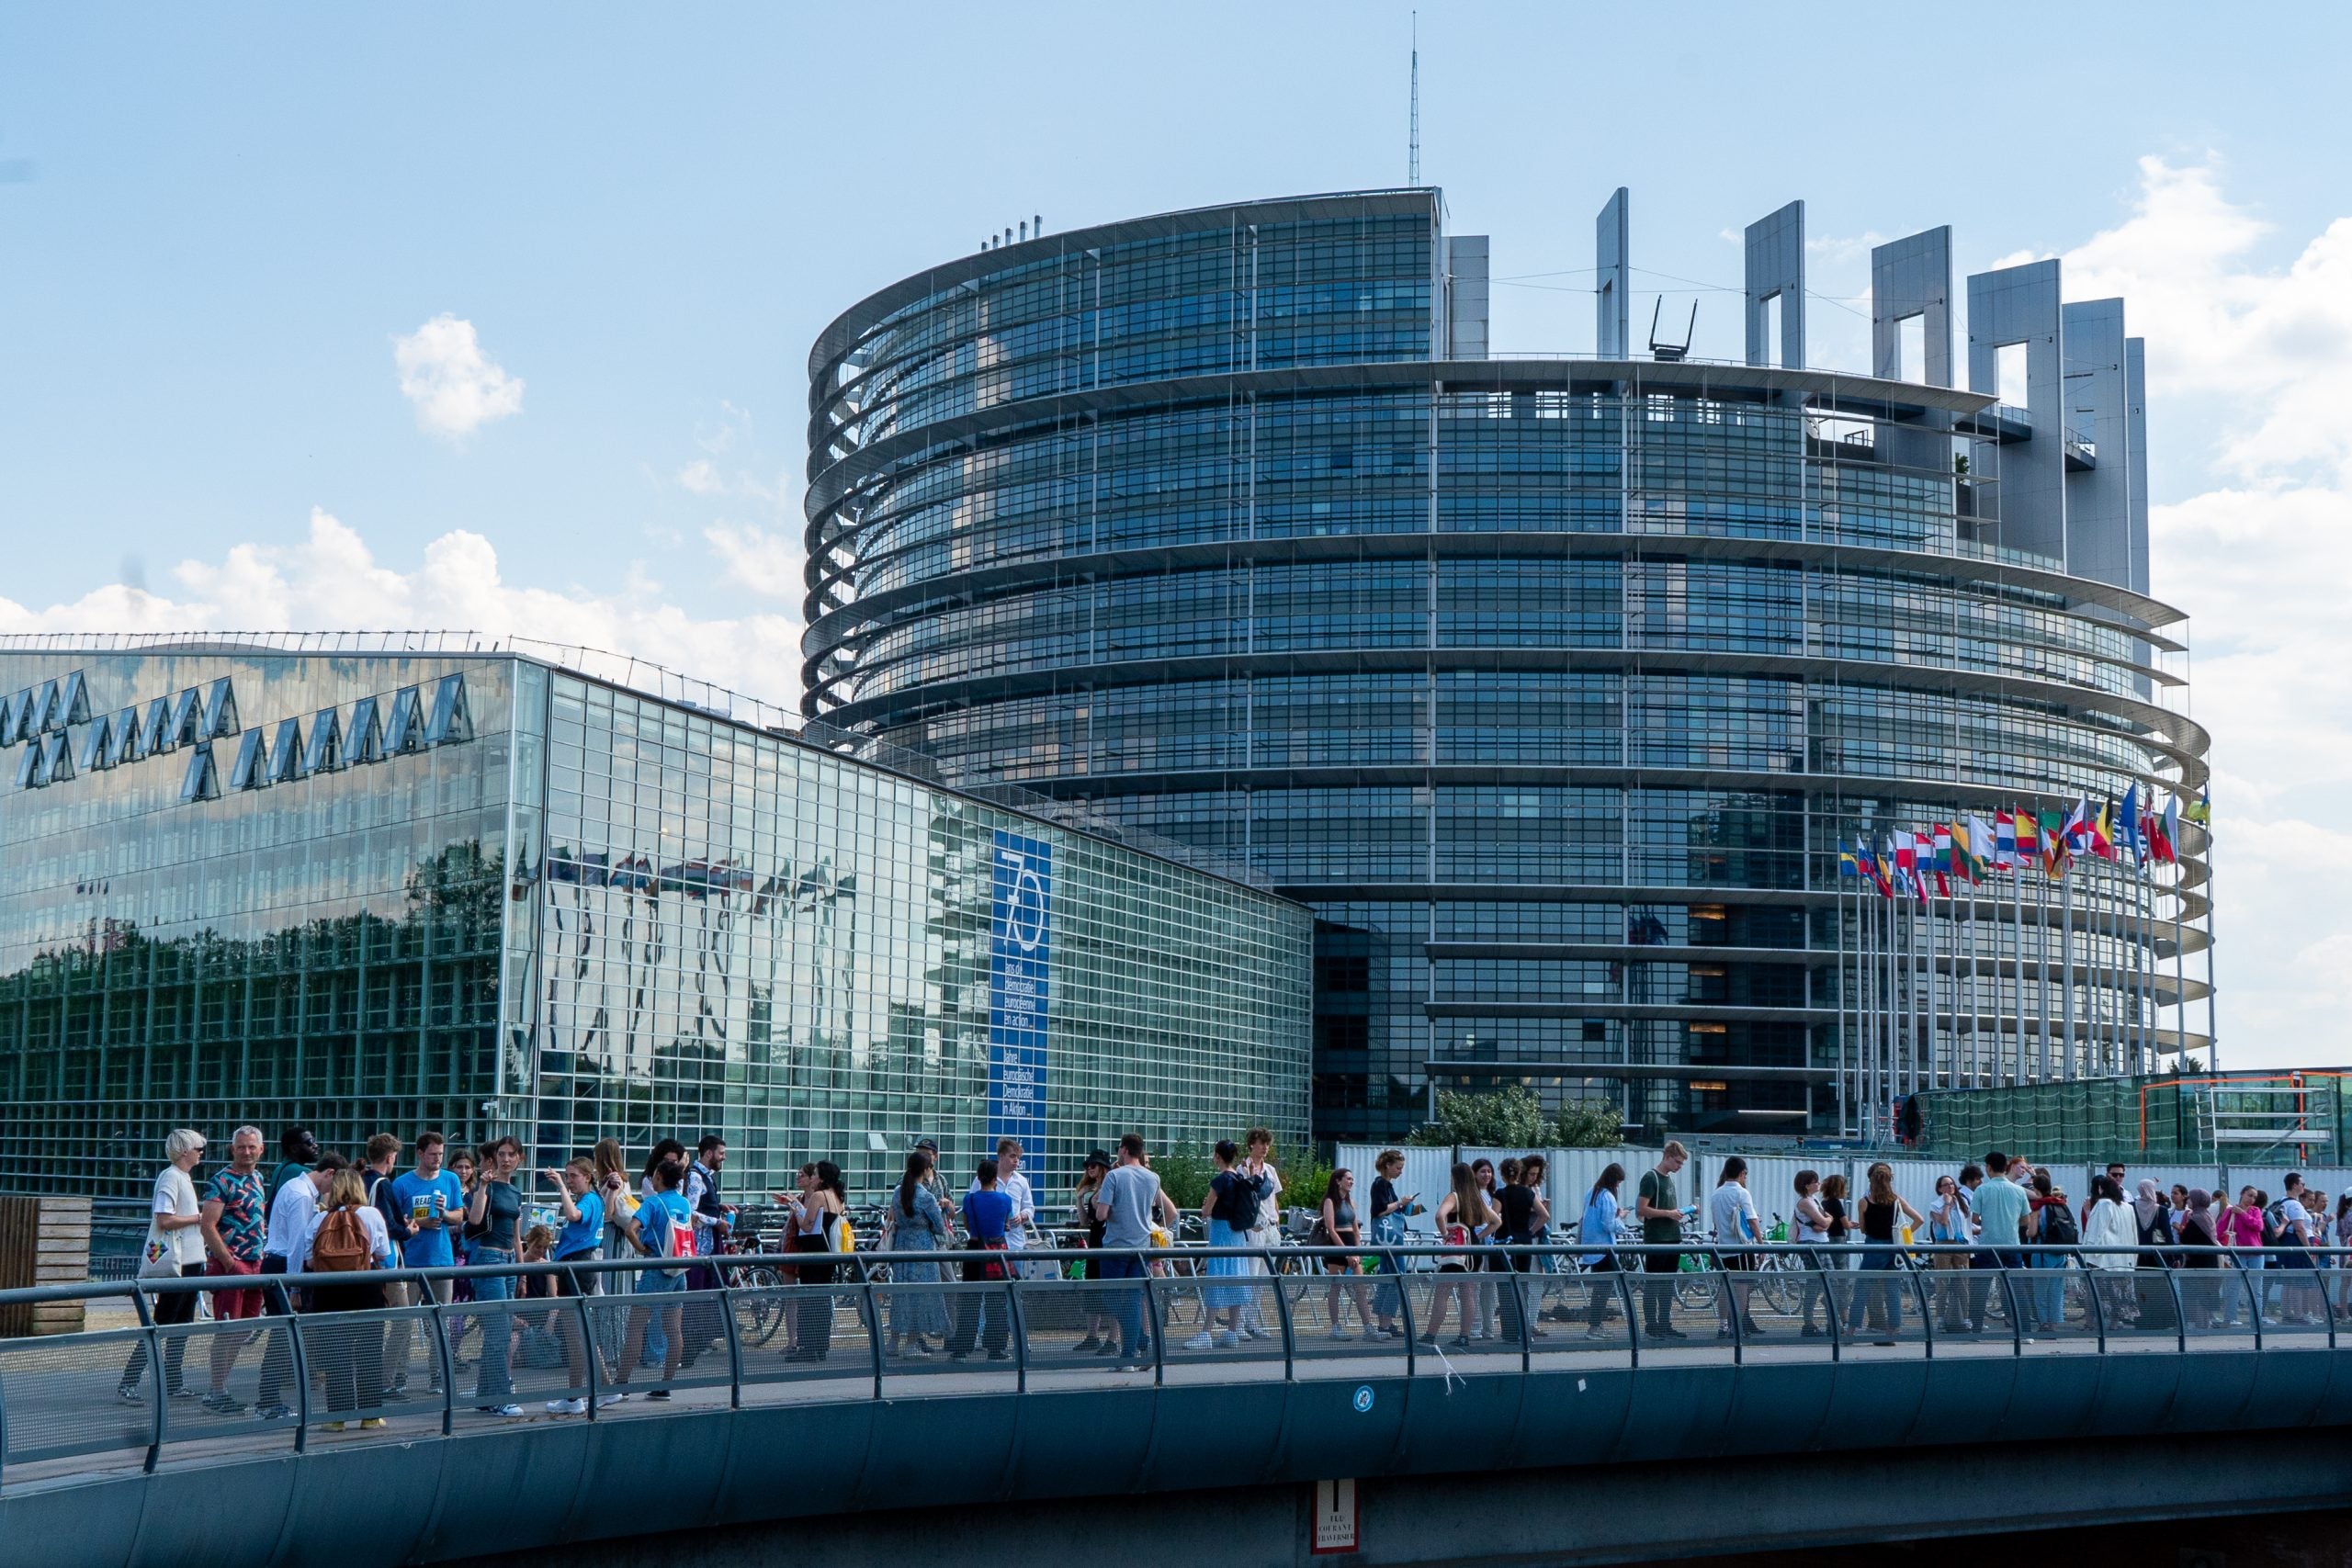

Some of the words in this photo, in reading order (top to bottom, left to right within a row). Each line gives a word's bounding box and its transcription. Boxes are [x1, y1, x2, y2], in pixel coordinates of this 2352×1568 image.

[1001, 851, 1044, 952] 70
[1005, 996, 1035, 1010] européenne
[1012, 1013, 1029, 1028] action
[1003, 1084, 1034, 1100] Demokratie
[414, 1197, 432, 1206] READ
